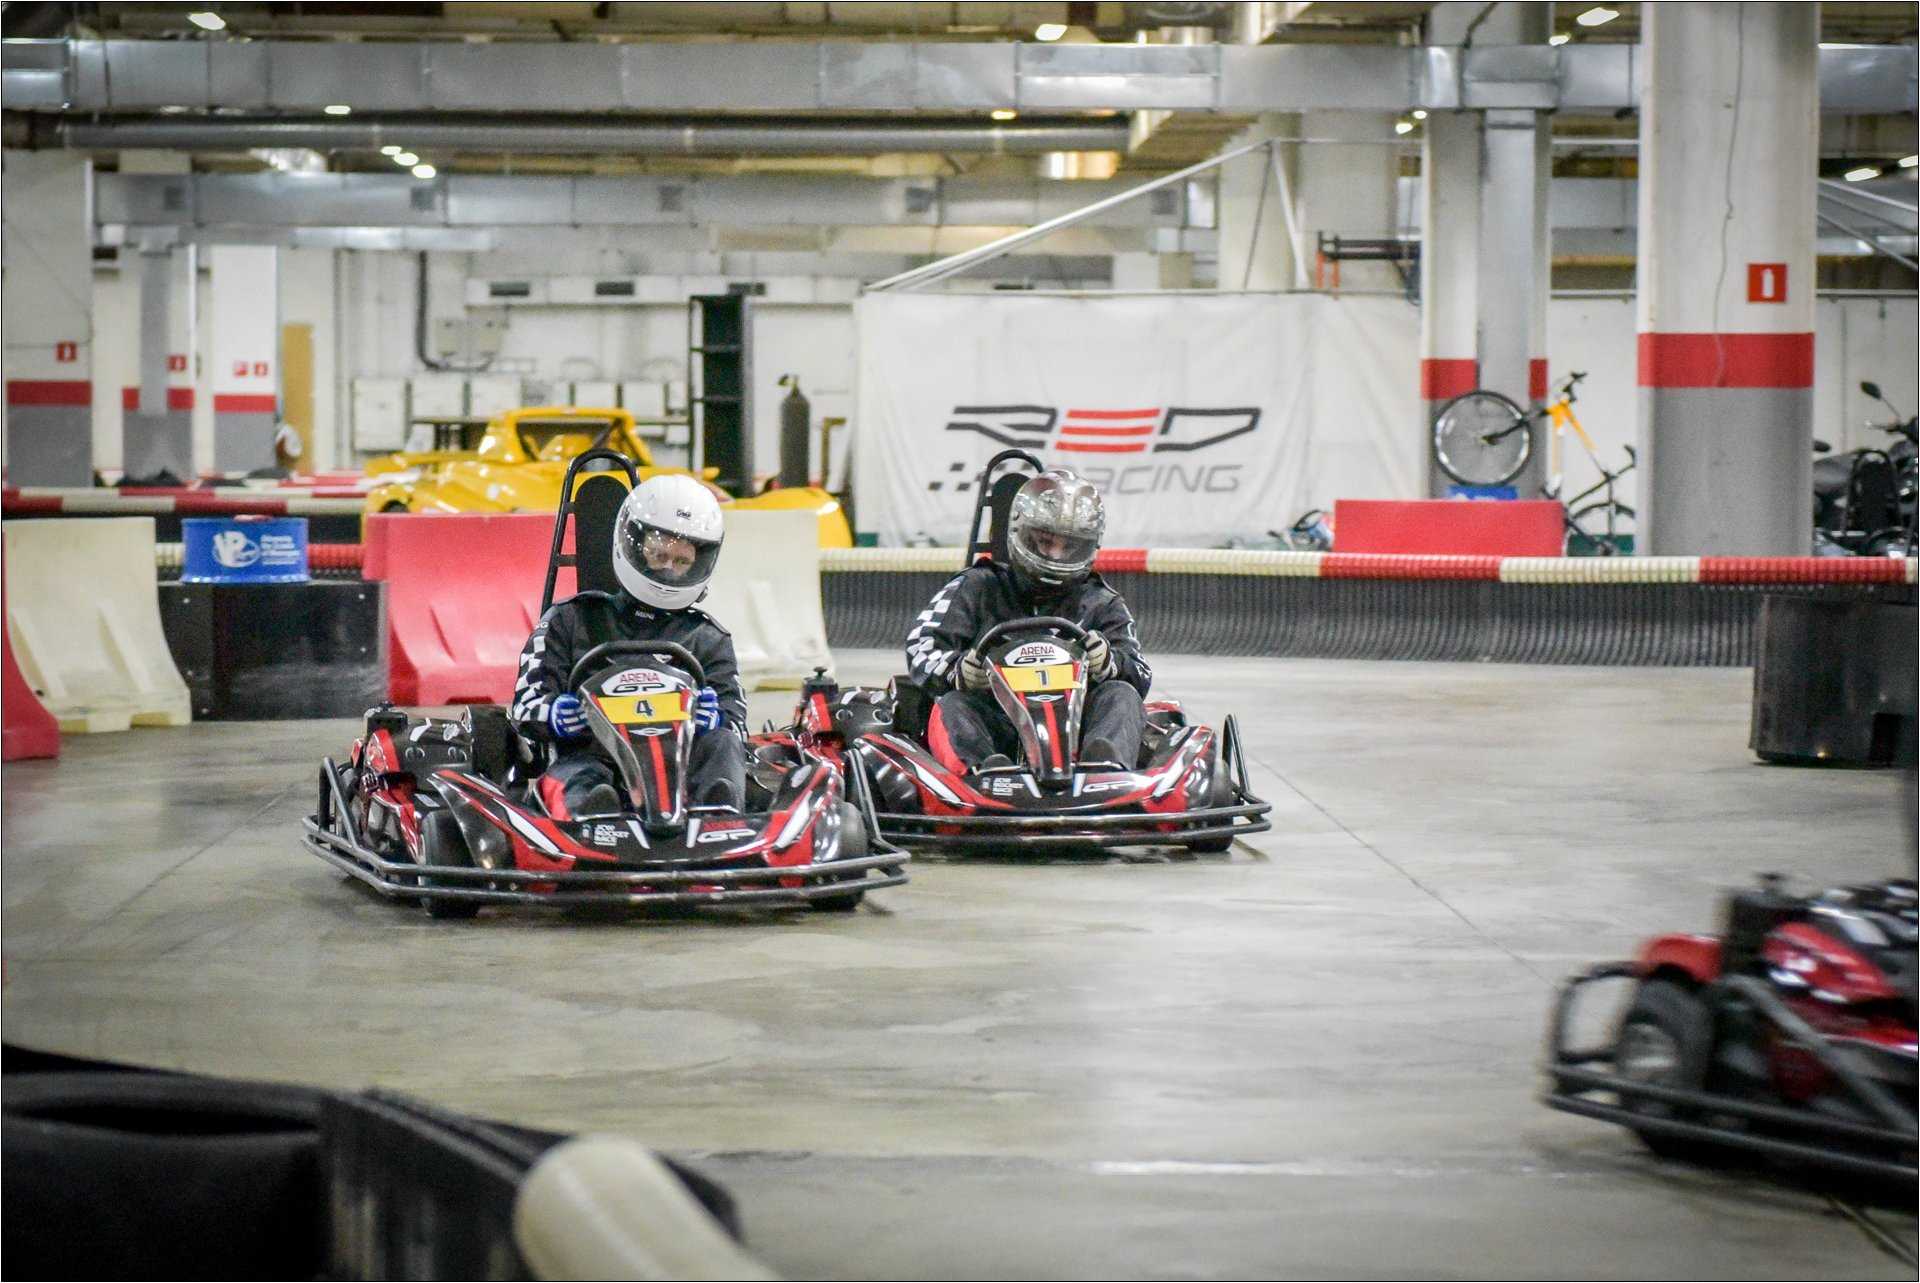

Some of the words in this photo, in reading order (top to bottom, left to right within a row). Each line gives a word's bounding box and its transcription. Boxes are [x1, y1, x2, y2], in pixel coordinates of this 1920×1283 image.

[945, 404, 1262, 453] RED
[1047, 464, 1244, 495] ACING
[1019, 645, 1055, 656] ARENA
[620, 672, 660, 683] ARENA
[612, 682, 666, 694] GP
[636, 699, 653, 717] 4
[697, 828, 757, 843] GP
